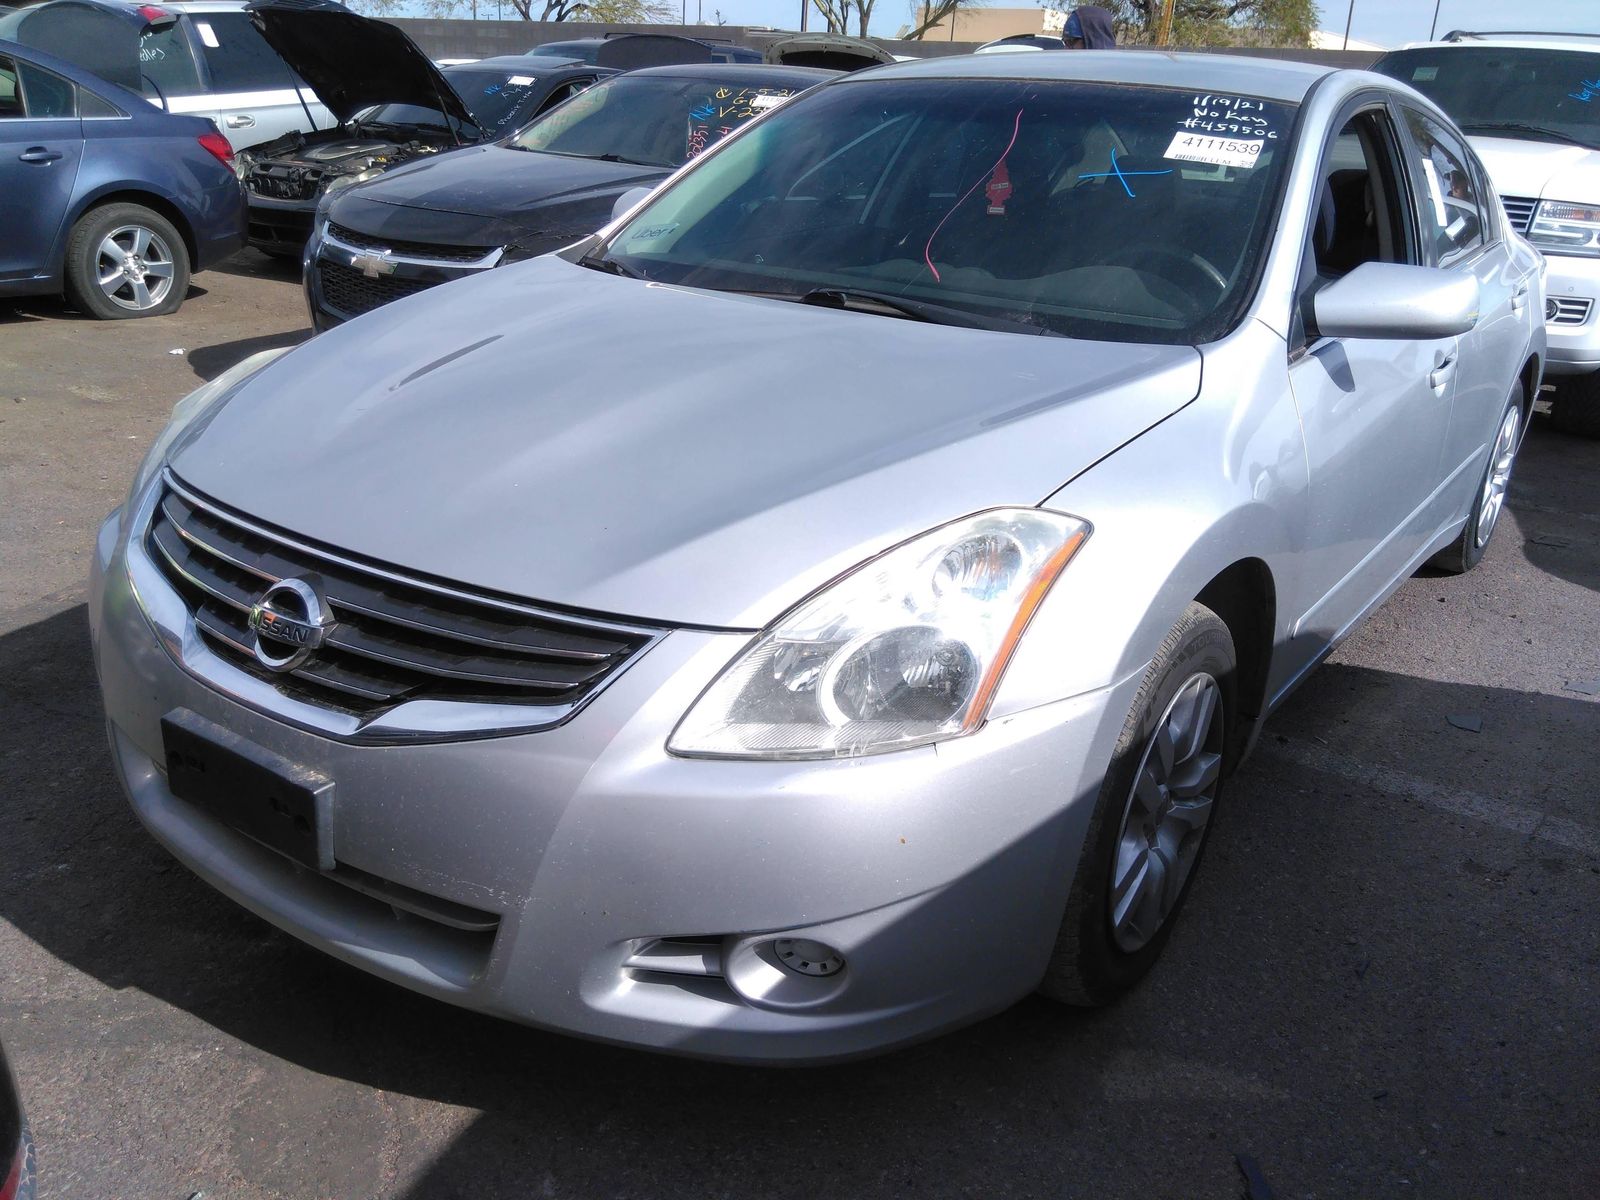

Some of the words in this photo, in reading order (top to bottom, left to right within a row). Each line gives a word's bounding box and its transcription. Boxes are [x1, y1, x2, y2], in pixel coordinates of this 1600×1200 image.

[1194, 108, 1219, 117] No
[1225, 110, 1268, 126] Key
[1182, 136, 1261, 155] 4111539
[249, 605, 308, 643] NISSAN
